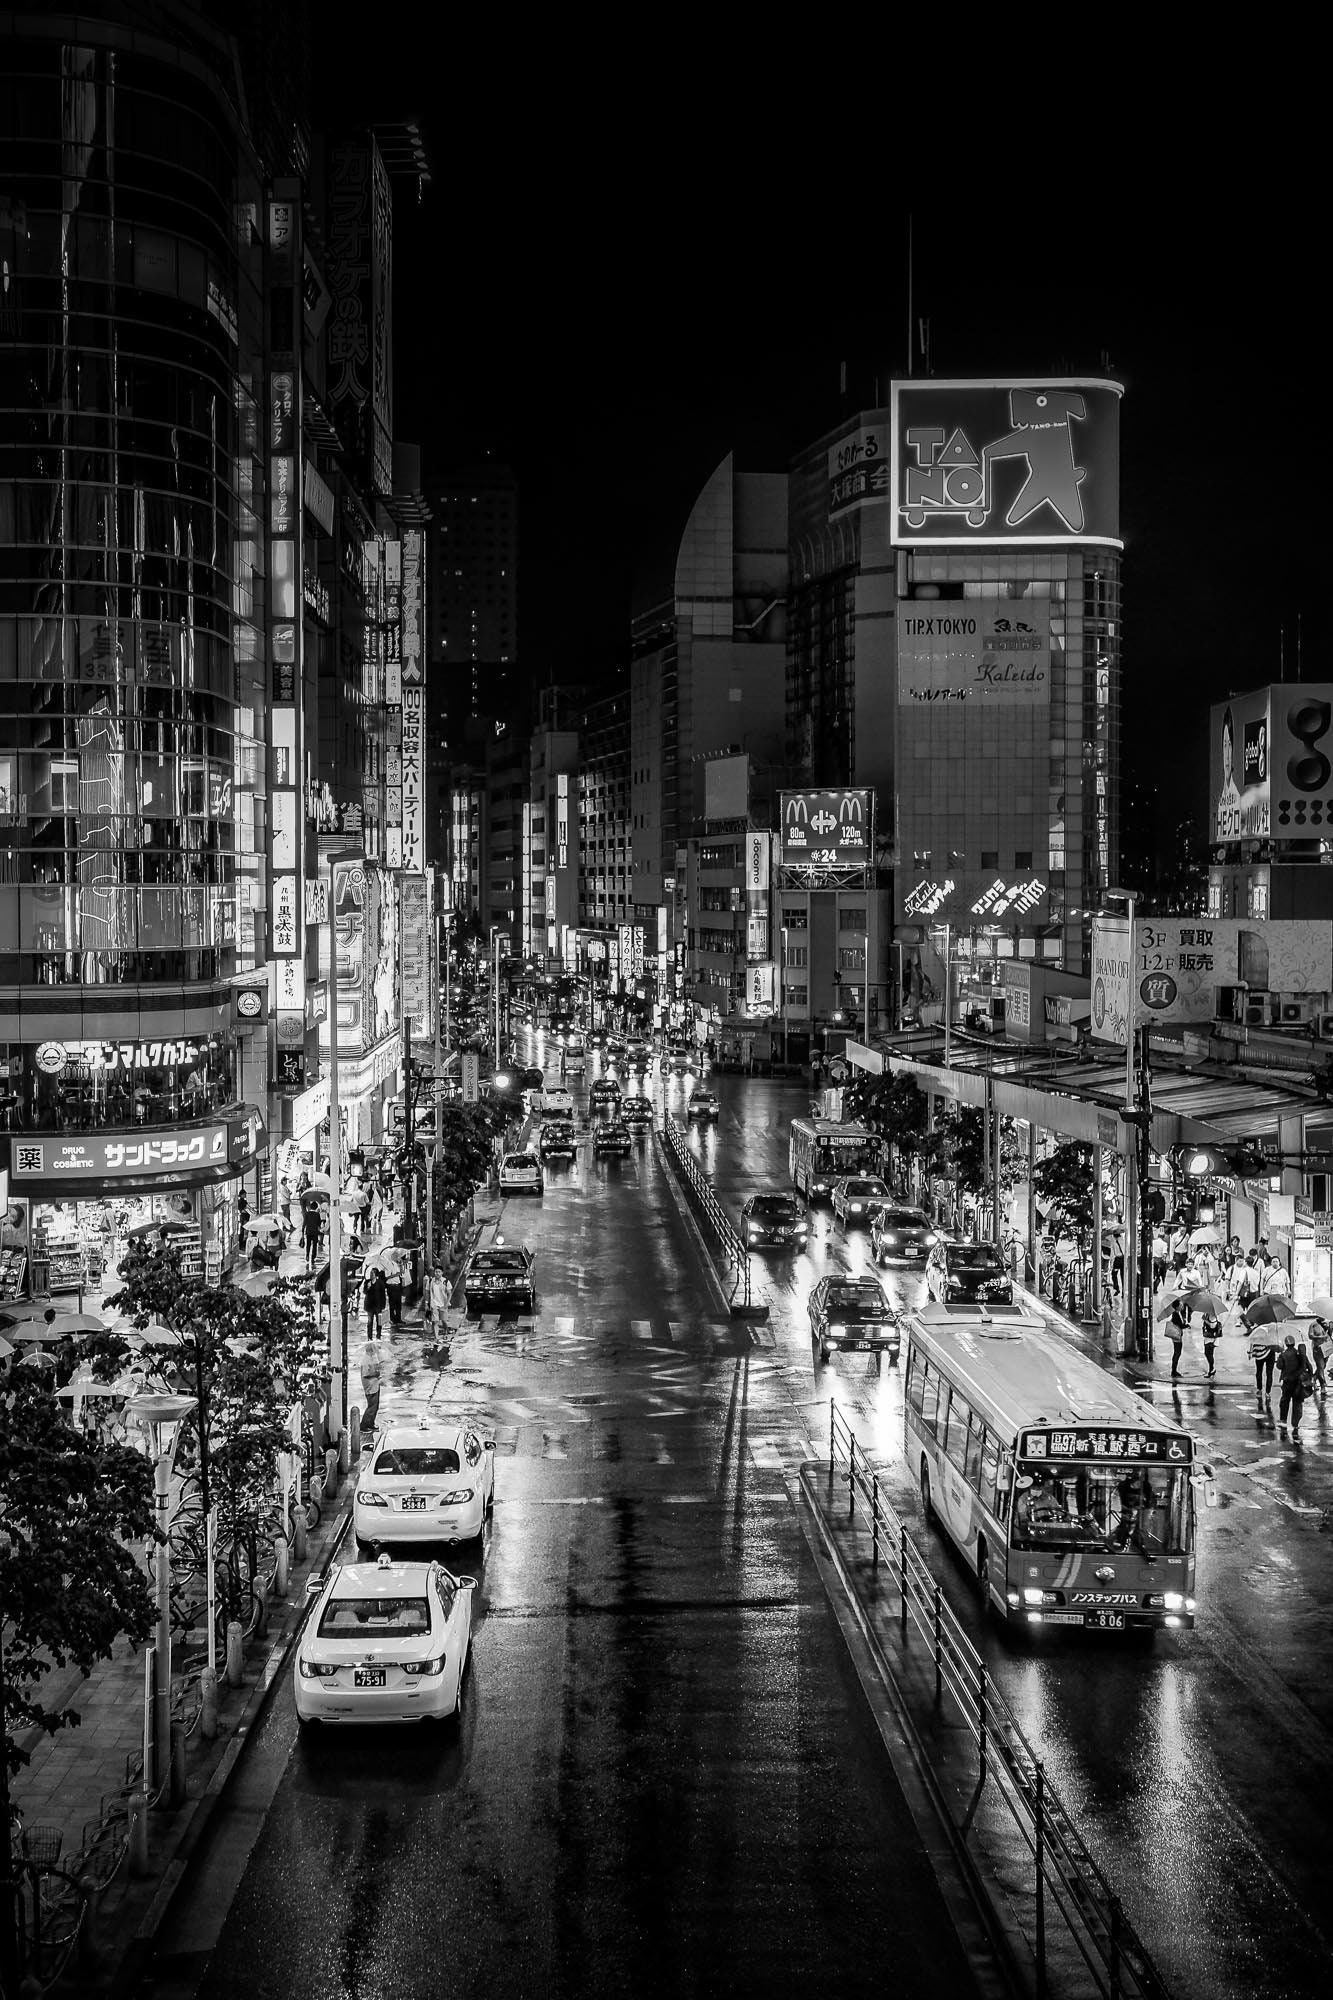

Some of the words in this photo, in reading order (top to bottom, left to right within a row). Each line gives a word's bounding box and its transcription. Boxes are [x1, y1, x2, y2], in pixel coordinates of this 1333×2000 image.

[273, 400, 283, 446] クリニック
[937, 618, 976, 635] TOKYO
[974, 664, 1045, 685] Kaleido
[403, 689, 420, 872] 100名収容大パーティールーム
[789, 827, 805, 839] 80m
[841, 826, 861, 838] 120m
[753, 838, 762, 884] docomo
[821, 849, 837, 862] 24
[1141, 927, 1167, 949] 3F
[1179, 929, 1214, 947] 買取
[1095, 957, 1117, 976] BRAND
[1179, 953, 1214, 971] 販売
[1147, 980, 1171, 1003] 質
[85, 1041, 199, 1069] サンマルクカフェ
[18, 1148, 42, 1170] 薬
[62, 1146, 85, 1155] DRUG
[105, 1136, 206, 1168] サンドラッグ
[53, 1160, 94, 1169] COSMETIC
[1072, 1592, 1138, 1605] ノンステップバス
